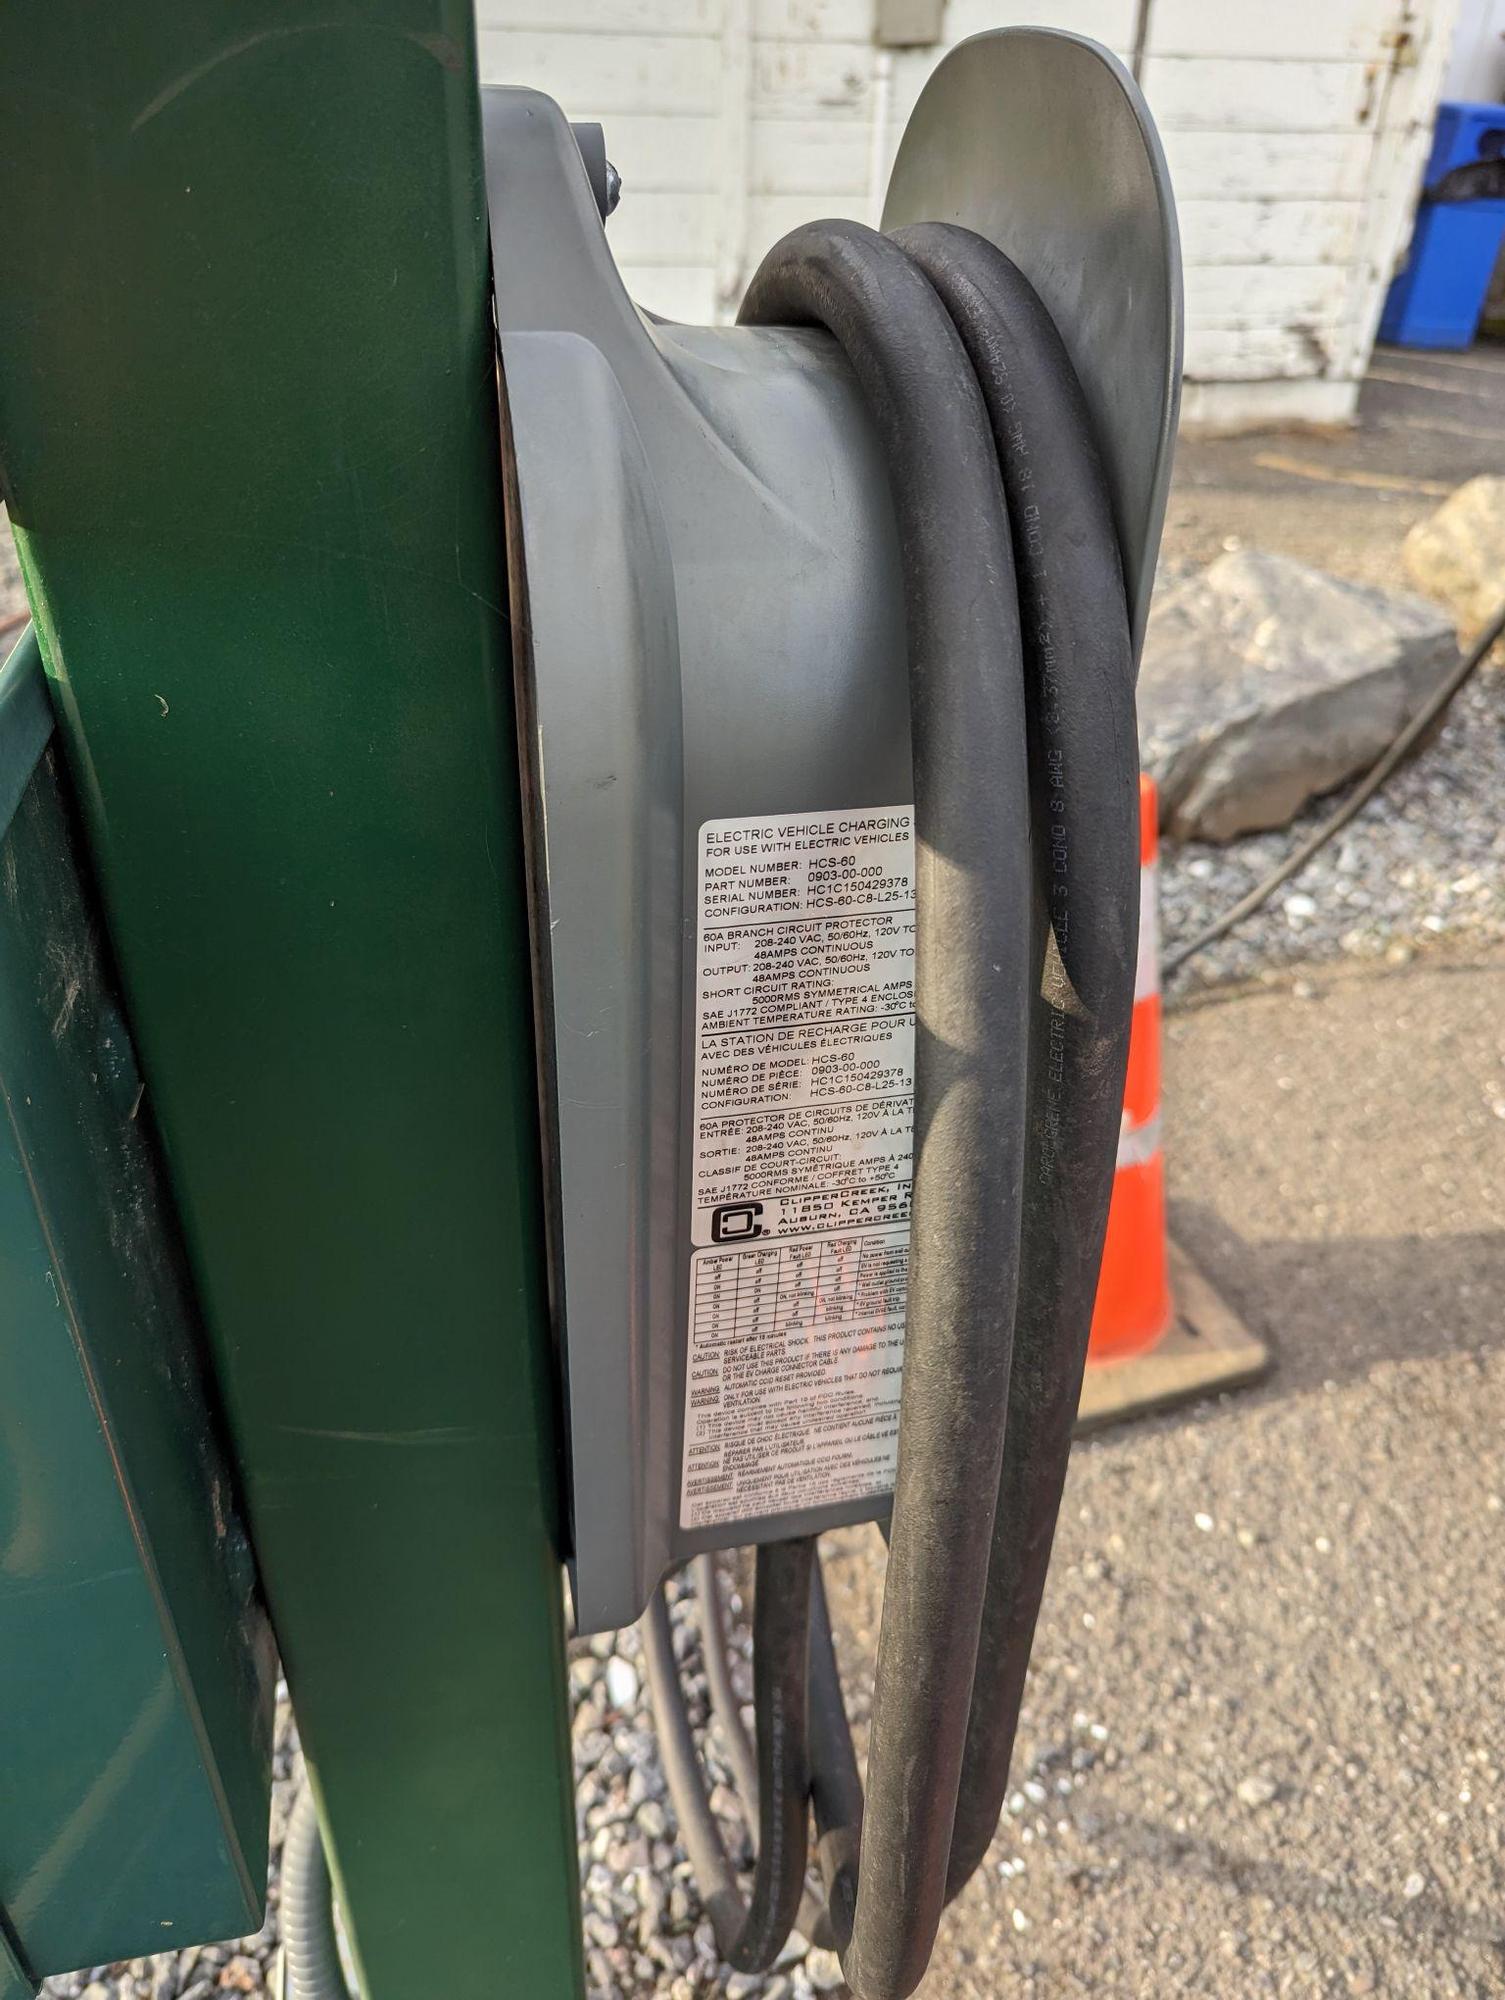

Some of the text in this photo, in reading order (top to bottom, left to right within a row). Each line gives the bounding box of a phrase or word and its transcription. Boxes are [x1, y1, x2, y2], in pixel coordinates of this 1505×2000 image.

[1048, 750, 1065, 788] AWG
[706, 816, 909, 843] ELECTRIC VEHICLE CHARGING
[706, 831, 909, 858] FOR USE WITH ELECTRIC VEHICLES
[1051, 824, 1069, 873] COND
[704, 866, 882, 891] PART NUMBER: 0903-00-000
[705, 855, 855, 878] MODEL NUMBER: HCS-60
[704, 877, 908, 905] SERIAL NUMBER: HC1C150429378
[1053, 884, 1069, 897] 3
[704, 900, 802, 918] CONFIGURATION:
[703, 915, 892, 942] 60A BRANCH CIRCUIT PROTECTOR
[704, 941, 739, 953] INPUT:
[754, 936, 794, 948] 208-240
[798, 933, 823, 944] VAC,
[875, 925, 900, 936] 120V
[702, 964, 750, 977] OUTPUT:
[752, 960, 793, 972] 208-240
[797, 957, 821, 967] VAC,
[872, 949, 896, 960] 120V
[900, 947, 914, 957] TO
[753, 940, 873, 960] 48AMPS CONTINUOUS
[752, 963, 870, 983] 48AMPS CONTINUOUS
[702, 978, 833, 999] SHORT CIRCUIT RATING:
[752, 980, 912, 1005] 5000RMS SYMMETRICAL AMPS
[701, 1017, 749, 1031] AMBIENT
[753, 1008, 830, 1025] TEMPERATURE
[835, 1003, 877, 1016] RATING:
[702, 1010, 723, 1020] SAE
[727, 1007, 757, 1018] J1772
[760, 1000, 822, 1014] COMPLIANT
[832, 996, 858, 1006] TYPE
[861, 995, 867, 1003] 4
[871, 990, 915, 1002] ENCLOS
[701, 1030, 892, 1060] AVEC DES VÉHICULES ÉLECTRIQUES
[702, 1038, 716, 1049] LA
[721, 1032, 773, 1047] STATION
[778, 1030, 794, 1041] DE
[798, 1022, 867, 1038] RECHARGE
[871, 1017, 905, 1030] POUR
[1048, 998, 1065, 1084] ELECTRIC
[701, 1073, 748, 1088] NUMÉRO
[752, 1073, 765, 1083] DE
[811, 1059, 879, 1076] 0903-00-000
[702, 1062, 748, 1077] NUMÉRO
[752, 1062, 765, 1072] DE
[811, 1051, 854, 1065] HCS-60
[701, 1084, 748, 1099] NUMÉRO
[751, 1084, 764, 1093] DE
[810, 1067, 903, 1086] HC1C150429378
[701, 1091, 791, 1110] CONFIGURATION:
[699, 1122, 718, 1131] 60A
[721, 1114, 784, 1128] PROTECTOR
[788, 1112, 801, 1120] DE
[805, 1106, 851, 1118] CIRCUITS
[855, 1104, 868, 1112] DE
[746, 1122, 784, 1134] 208-240
[857, 1110, 879, 1120] 120V
[892, 1107, 903, 1116] LA
[745, 1125, 834, 1143] 48AMPS CONTINU
[746, 1142, 783, 1154] 208-240
[856, 1130, 878, 1140] 120V
[890, 1127, 902, 1136] LA
[745, 1144, 832, 1162] 48AMPS CONTINU
[697, 1186, 717, 1196] SAE
[720, 1182, 748, 1193] J1772
[751, 1174, 809, 1189] CONFORME
[817, 1167, 863, 1180] COFFRET
[866, 1164, 890, 1174] TYPE
[698, 1165, 741, 1178] CLASSIF
[743, 1163, 757, 1172] DE
[744, 1168, 788, 1181] 5000RMS
[858, 1156, 885, 1166] AMPS
[858, 1176, 866, 1184] to
[841, 1193, 897, 1207] KEMPER
[849, 1206, 869, 1216] CA
[877, 1201, 911, 1212] 956
